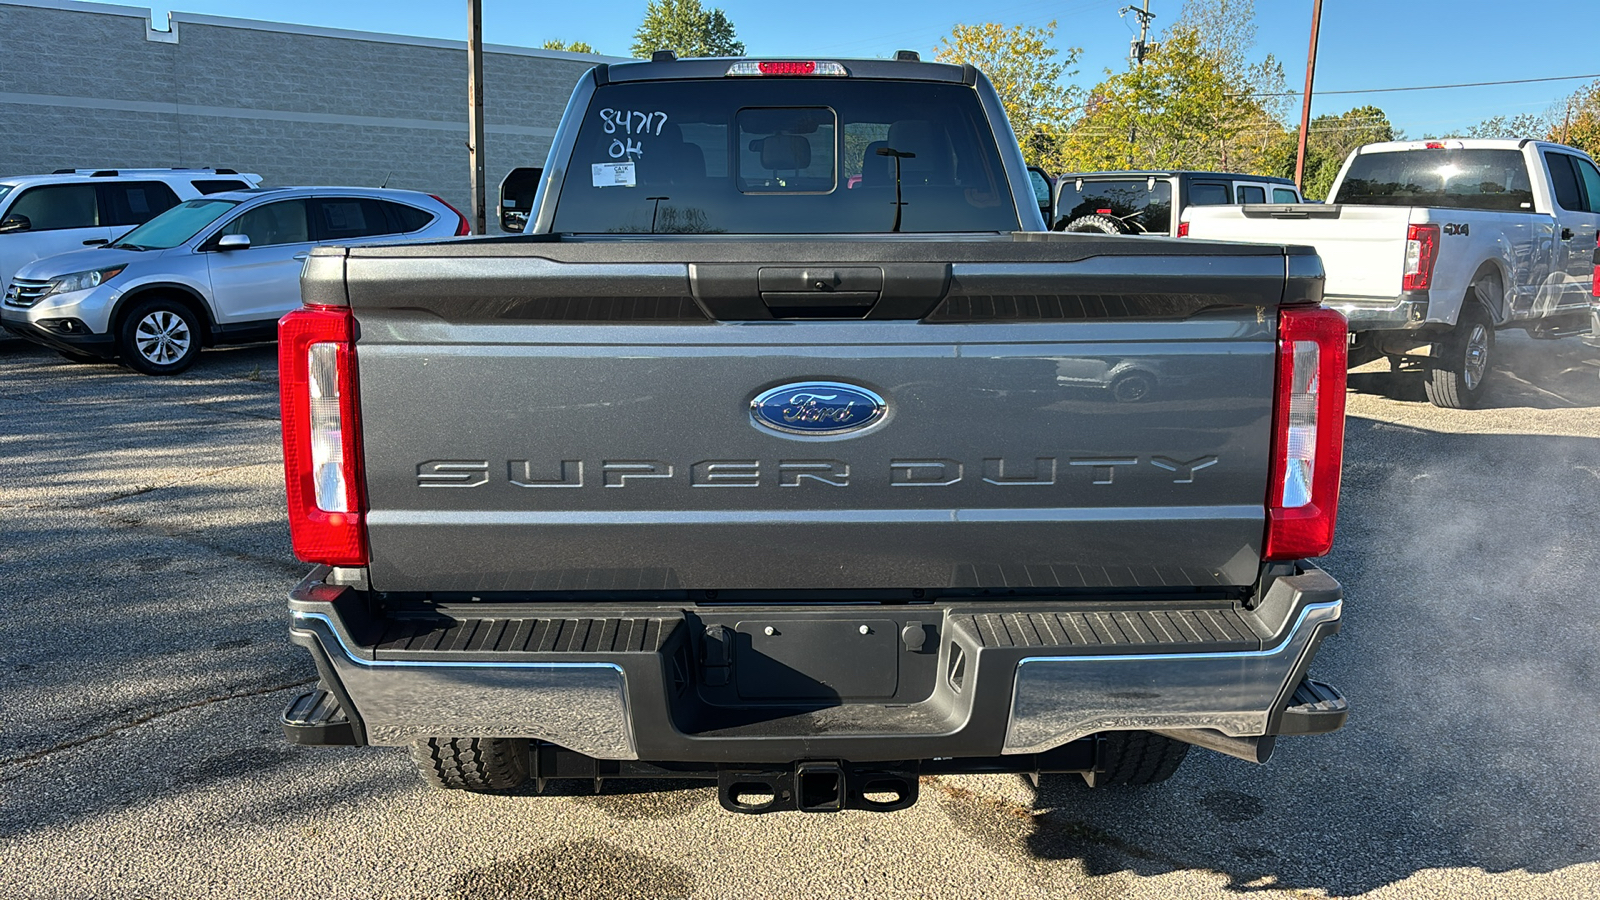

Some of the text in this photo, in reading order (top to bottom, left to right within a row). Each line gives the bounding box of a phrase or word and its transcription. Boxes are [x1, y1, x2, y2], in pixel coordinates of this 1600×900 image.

[599, 108, 668, 136] 84717
[783, 393, 855, 422] Ford
[416, 454, 1218, 488] SUPER DUTY
